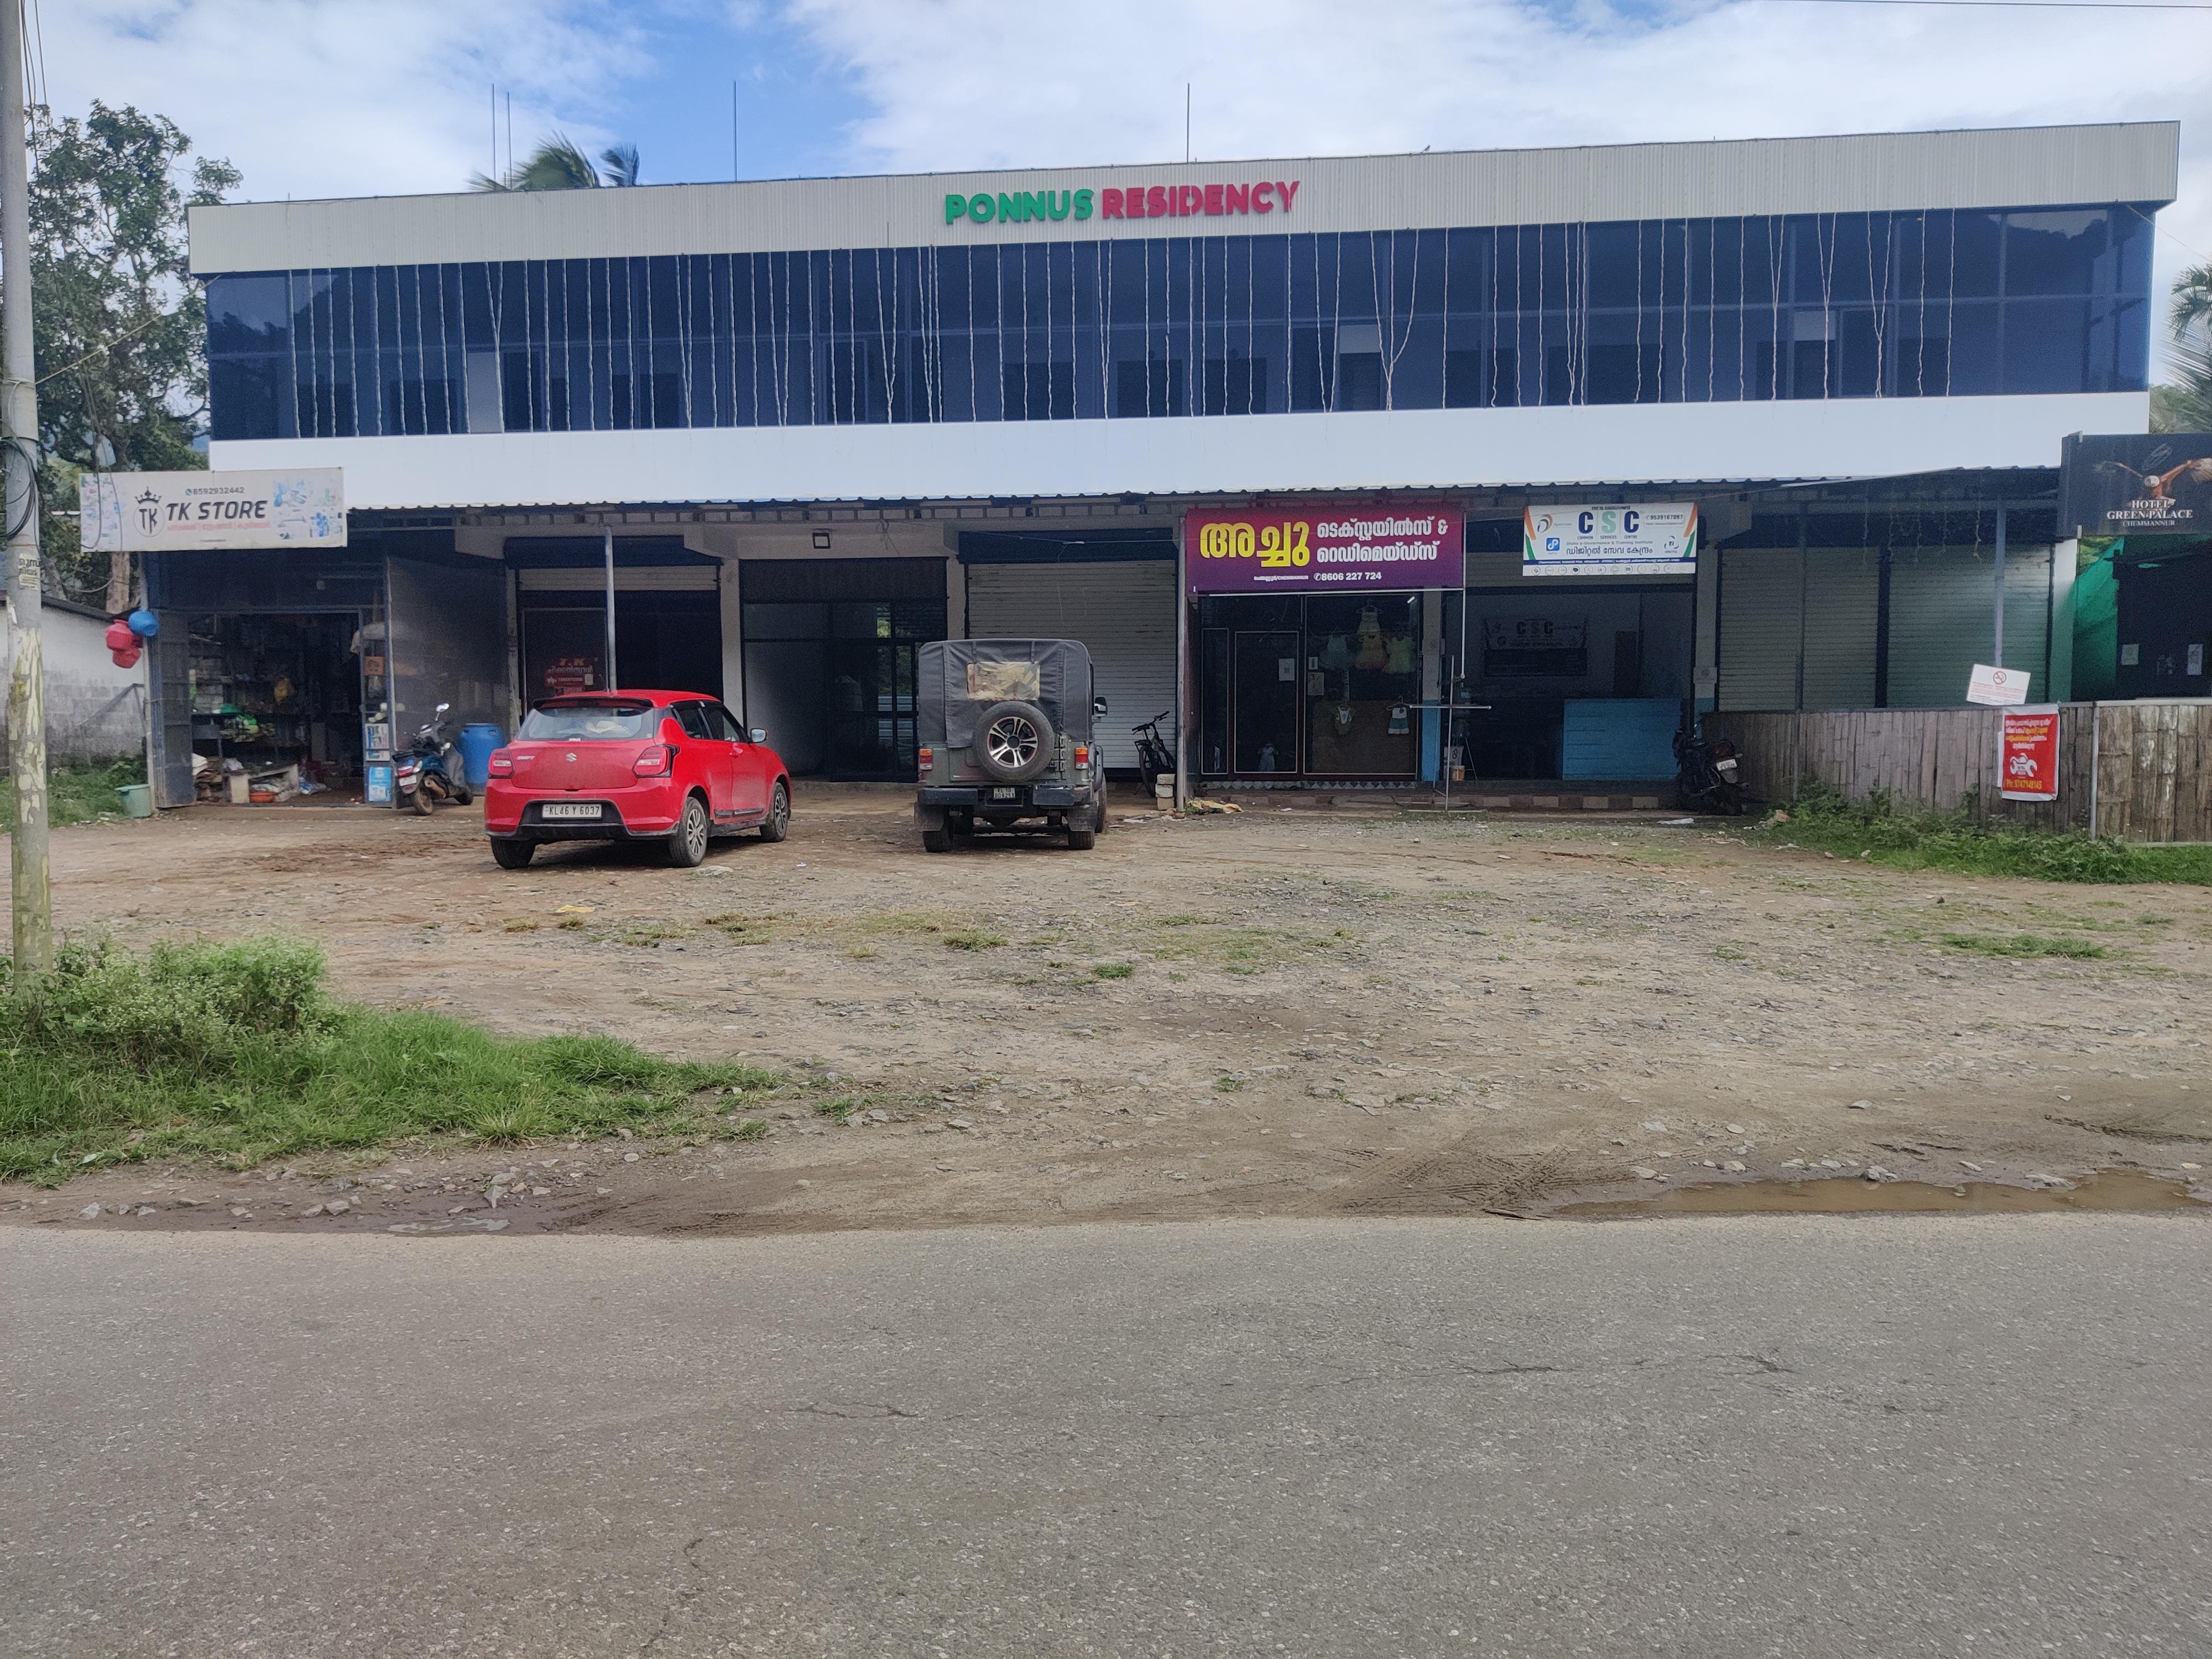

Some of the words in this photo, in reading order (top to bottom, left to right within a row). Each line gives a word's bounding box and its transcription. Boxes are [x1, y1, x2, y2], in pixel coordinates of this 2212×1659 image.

[945, 188, 1094, 225] PONNUS
[1102, 181, 1300, 220] RESIDENCY
[166, 502, 192, 521] TK
[198, 500, 268, 520] STORE
[2132, 499, 2168, 509] HOTEL
[1437, 519, 1448, 535] &
[1200, 521, 1310, 567] അച്ചു
[1321, 572, 1344, 581] 8606
[1345, 572, 1363, 581] 227
[1364, 571, 1382, 580] 724
[549, 806, 569, 816] KL46
[572, 806, 577, 815] Y
[580, 806, 600, 815] 6037
